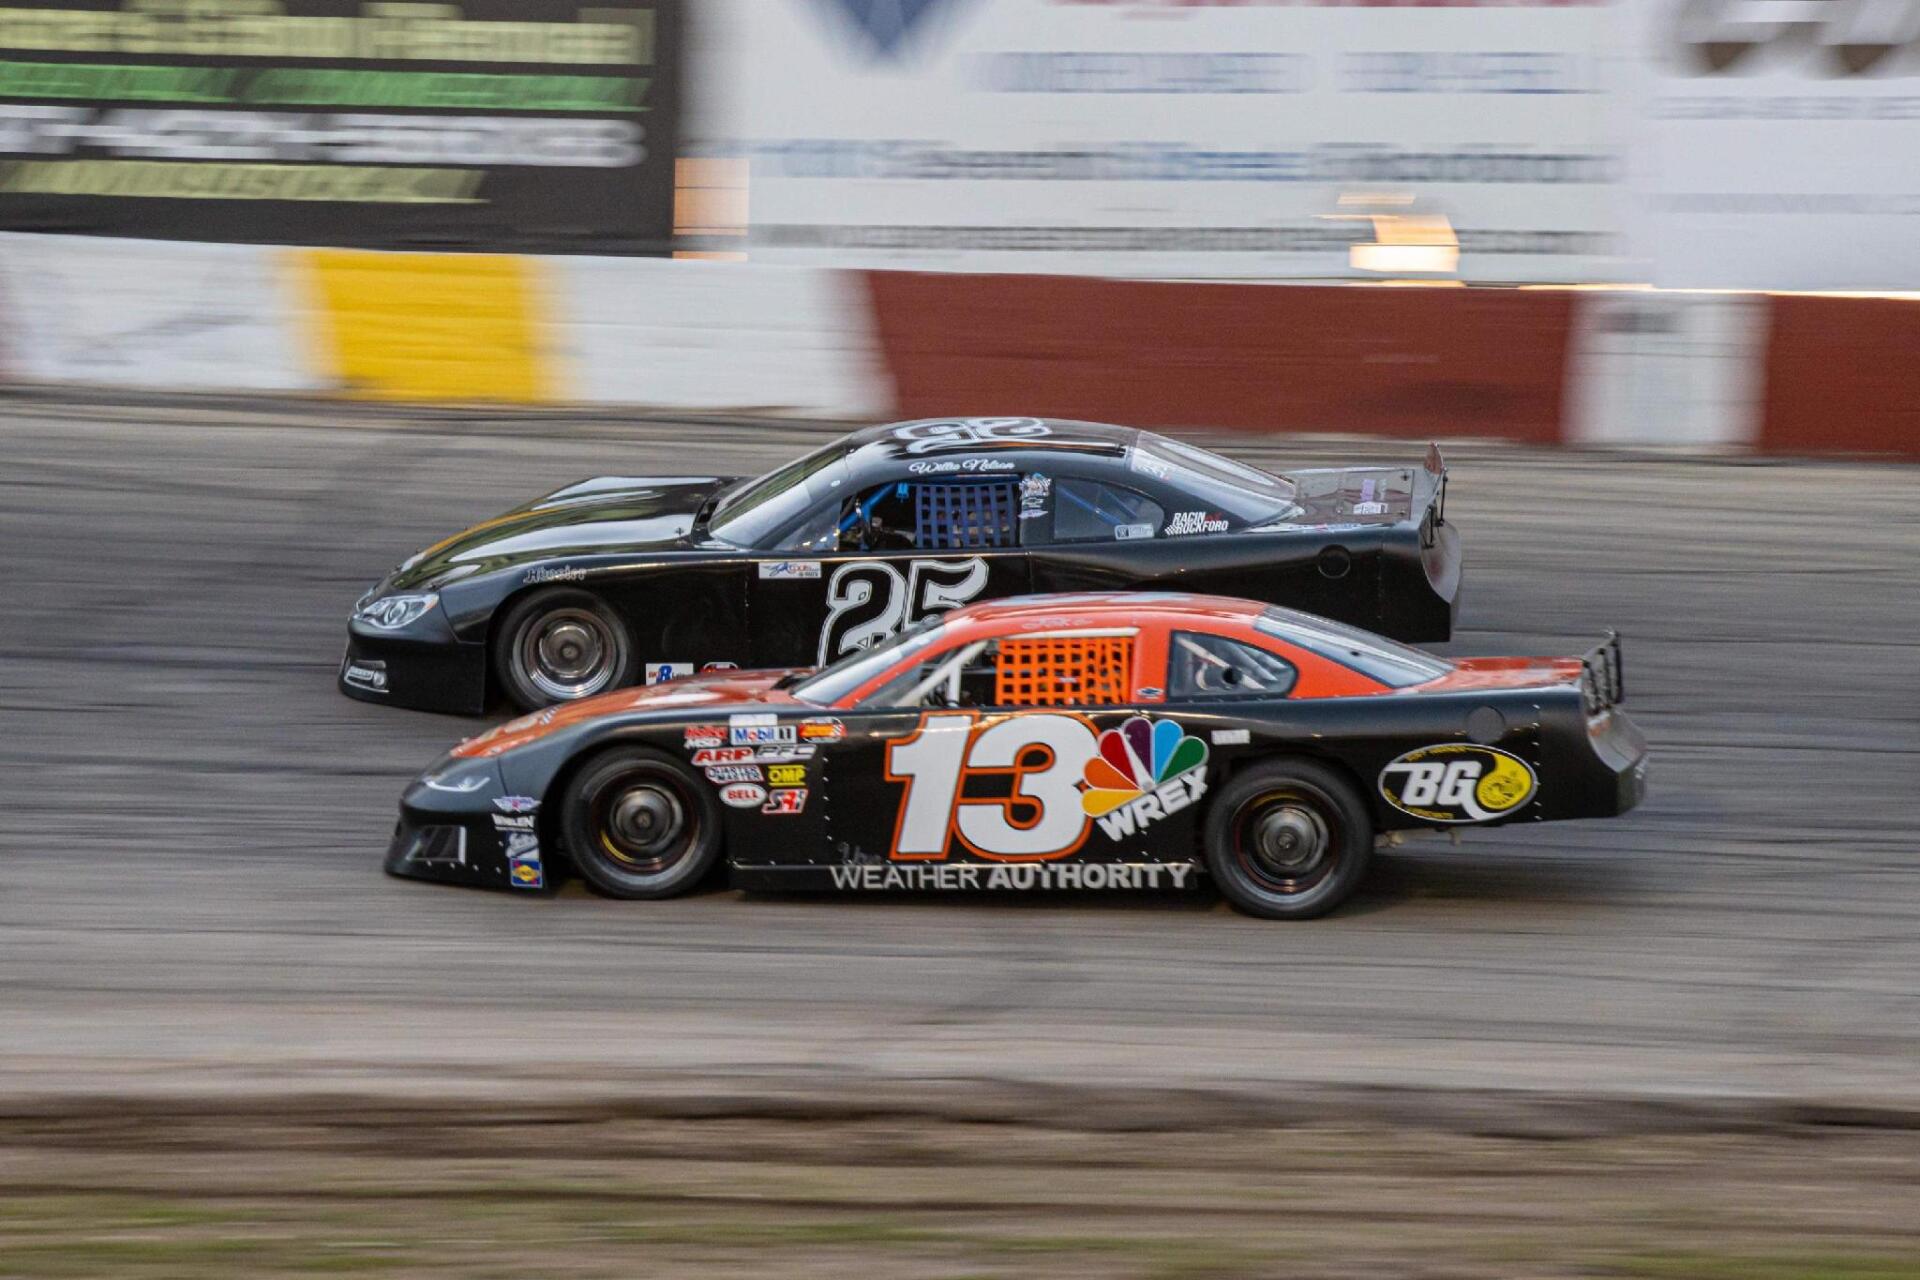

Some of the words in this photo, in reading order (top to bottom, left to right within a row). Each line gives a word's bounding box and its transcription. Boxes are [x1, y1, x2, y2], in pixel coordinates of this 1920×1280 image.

[1173, 511, 1207, 523] RACIN
[1174, 520, 1230, 535] ROCKFORD
[817, 556, 990, 669] 25
[735, 728, 775, 741] Mobil
[695, 748, 752, 762] ARP
[768, 768, 806, 783] OMP
[884, 709, 1104, 863] 13
[1384, 760, 1485, 813] BG
[727, 789, 759, 800] BELL
[1096, 765, 1208, 841] WREX
[829, 865, 980, 890] WEATHER
[987, 864, 1194, 890] AUTHORITY
